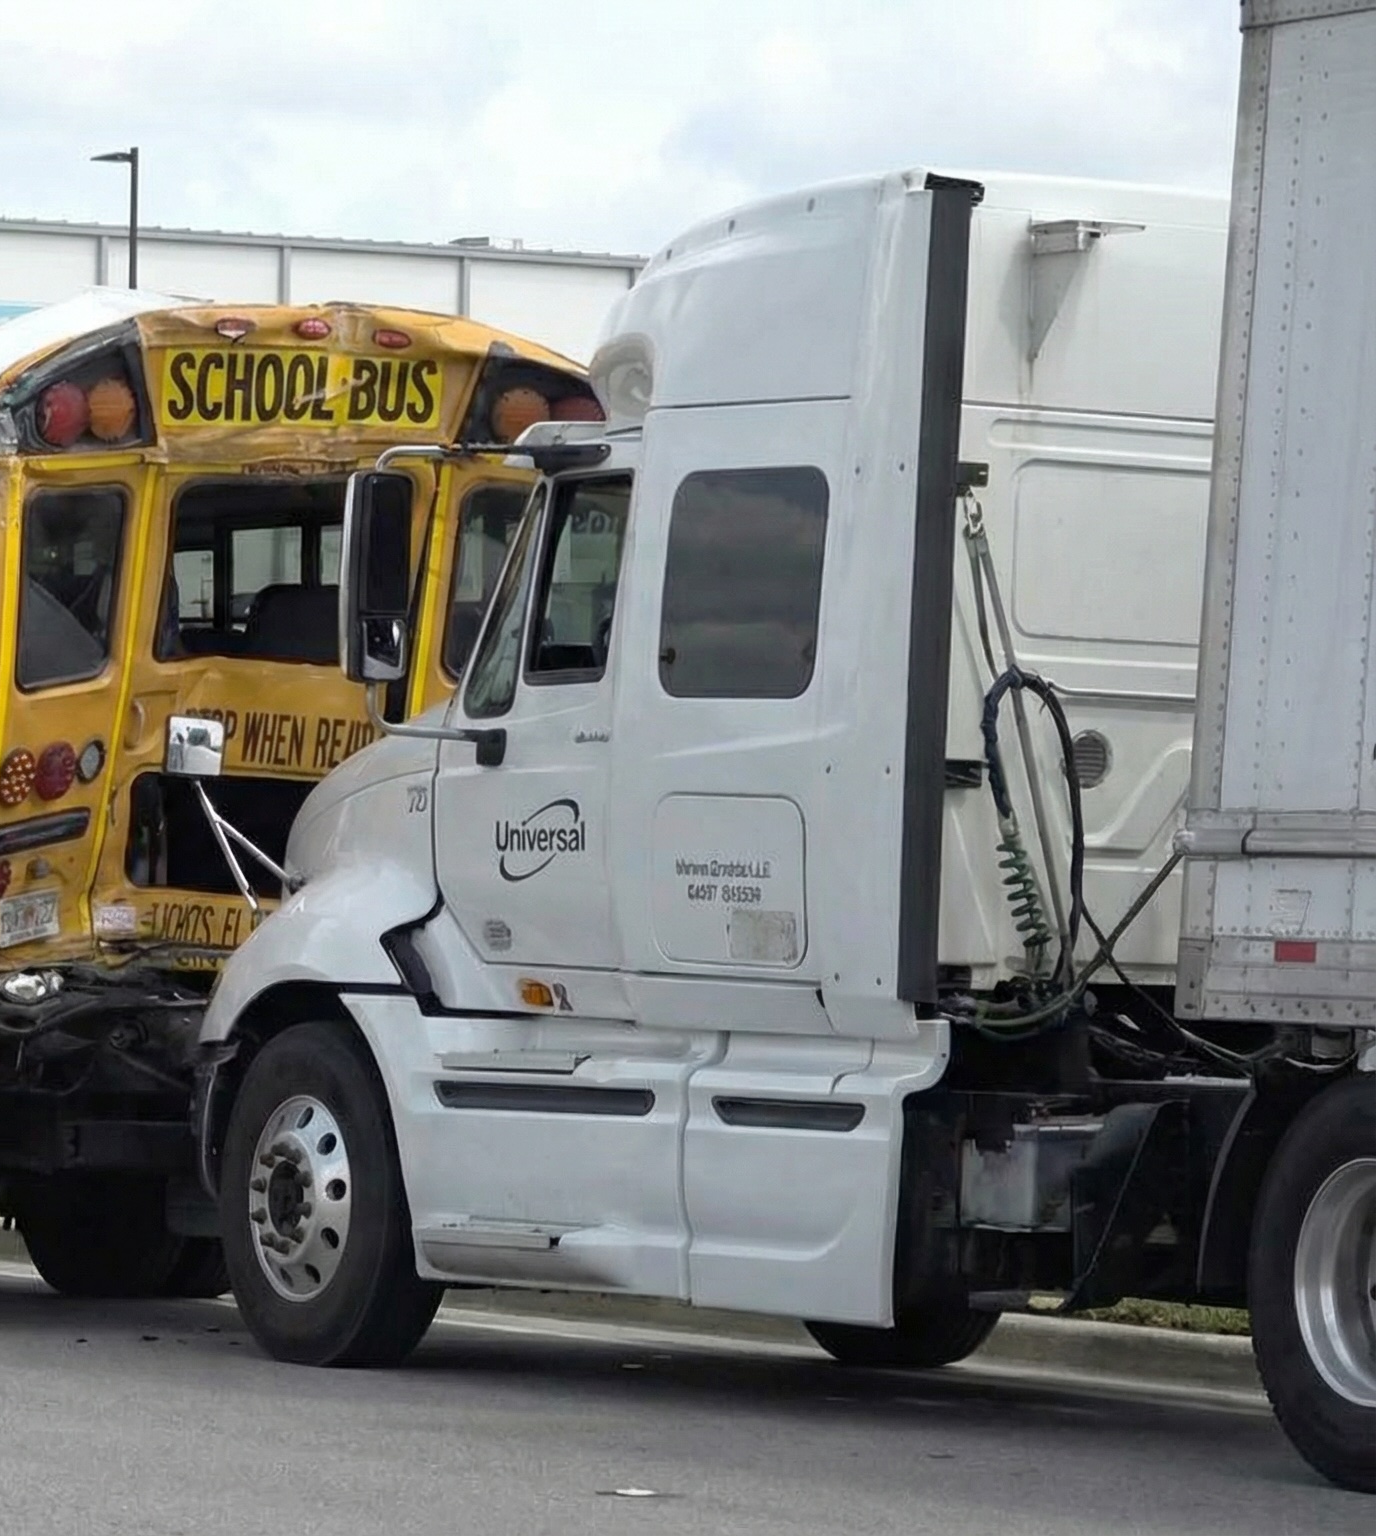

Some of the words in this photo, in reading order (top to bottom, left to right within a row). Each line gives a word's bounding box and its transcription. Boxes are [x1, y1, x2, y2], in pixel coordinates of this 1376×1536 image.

[167, 351, 334, 422] SCHOOL
[347, 358, 438, 422] BUS
[240, 711, 307, 767] WHEN
[495, 820, 586, 852] Universal
